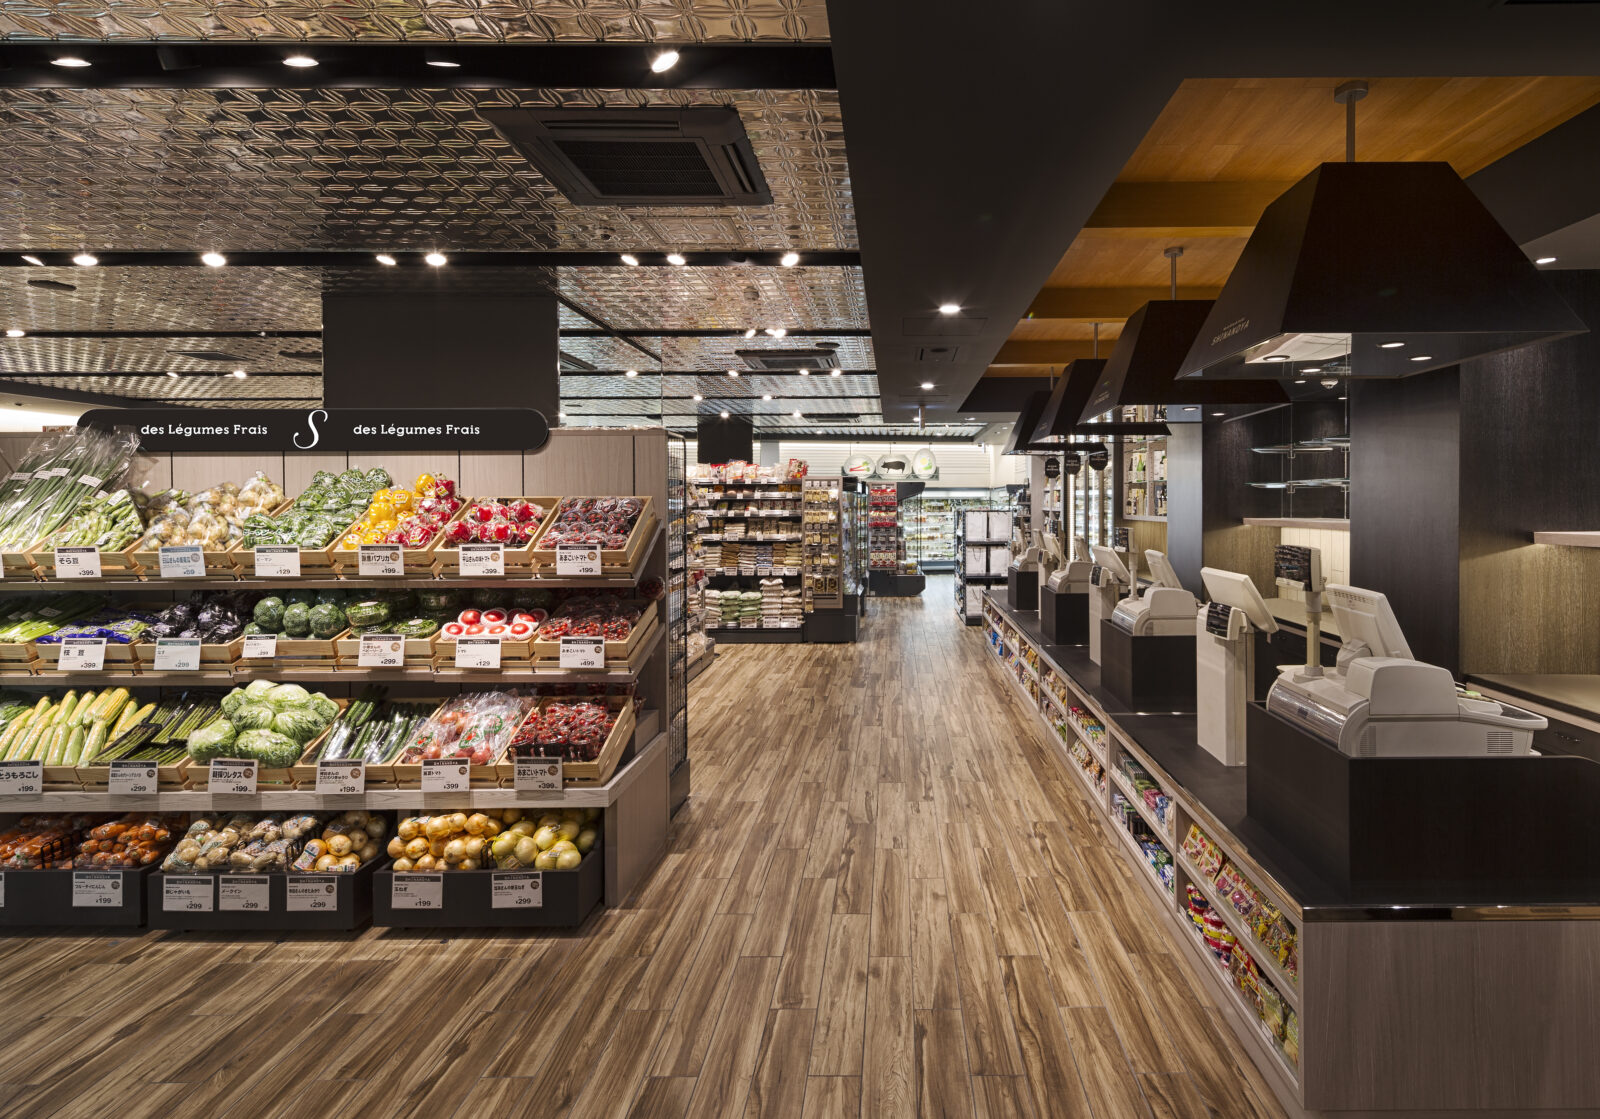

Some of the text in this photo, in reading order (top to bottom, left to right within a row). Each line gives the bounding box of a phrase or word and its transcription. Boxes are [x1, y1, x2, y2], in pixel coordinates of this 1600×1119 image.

[140, 423, 268, 437] des Légumes Frais
[353, 423, 480, 437] des Légumes Frais
[58, 557, 79, 565] そら豆
